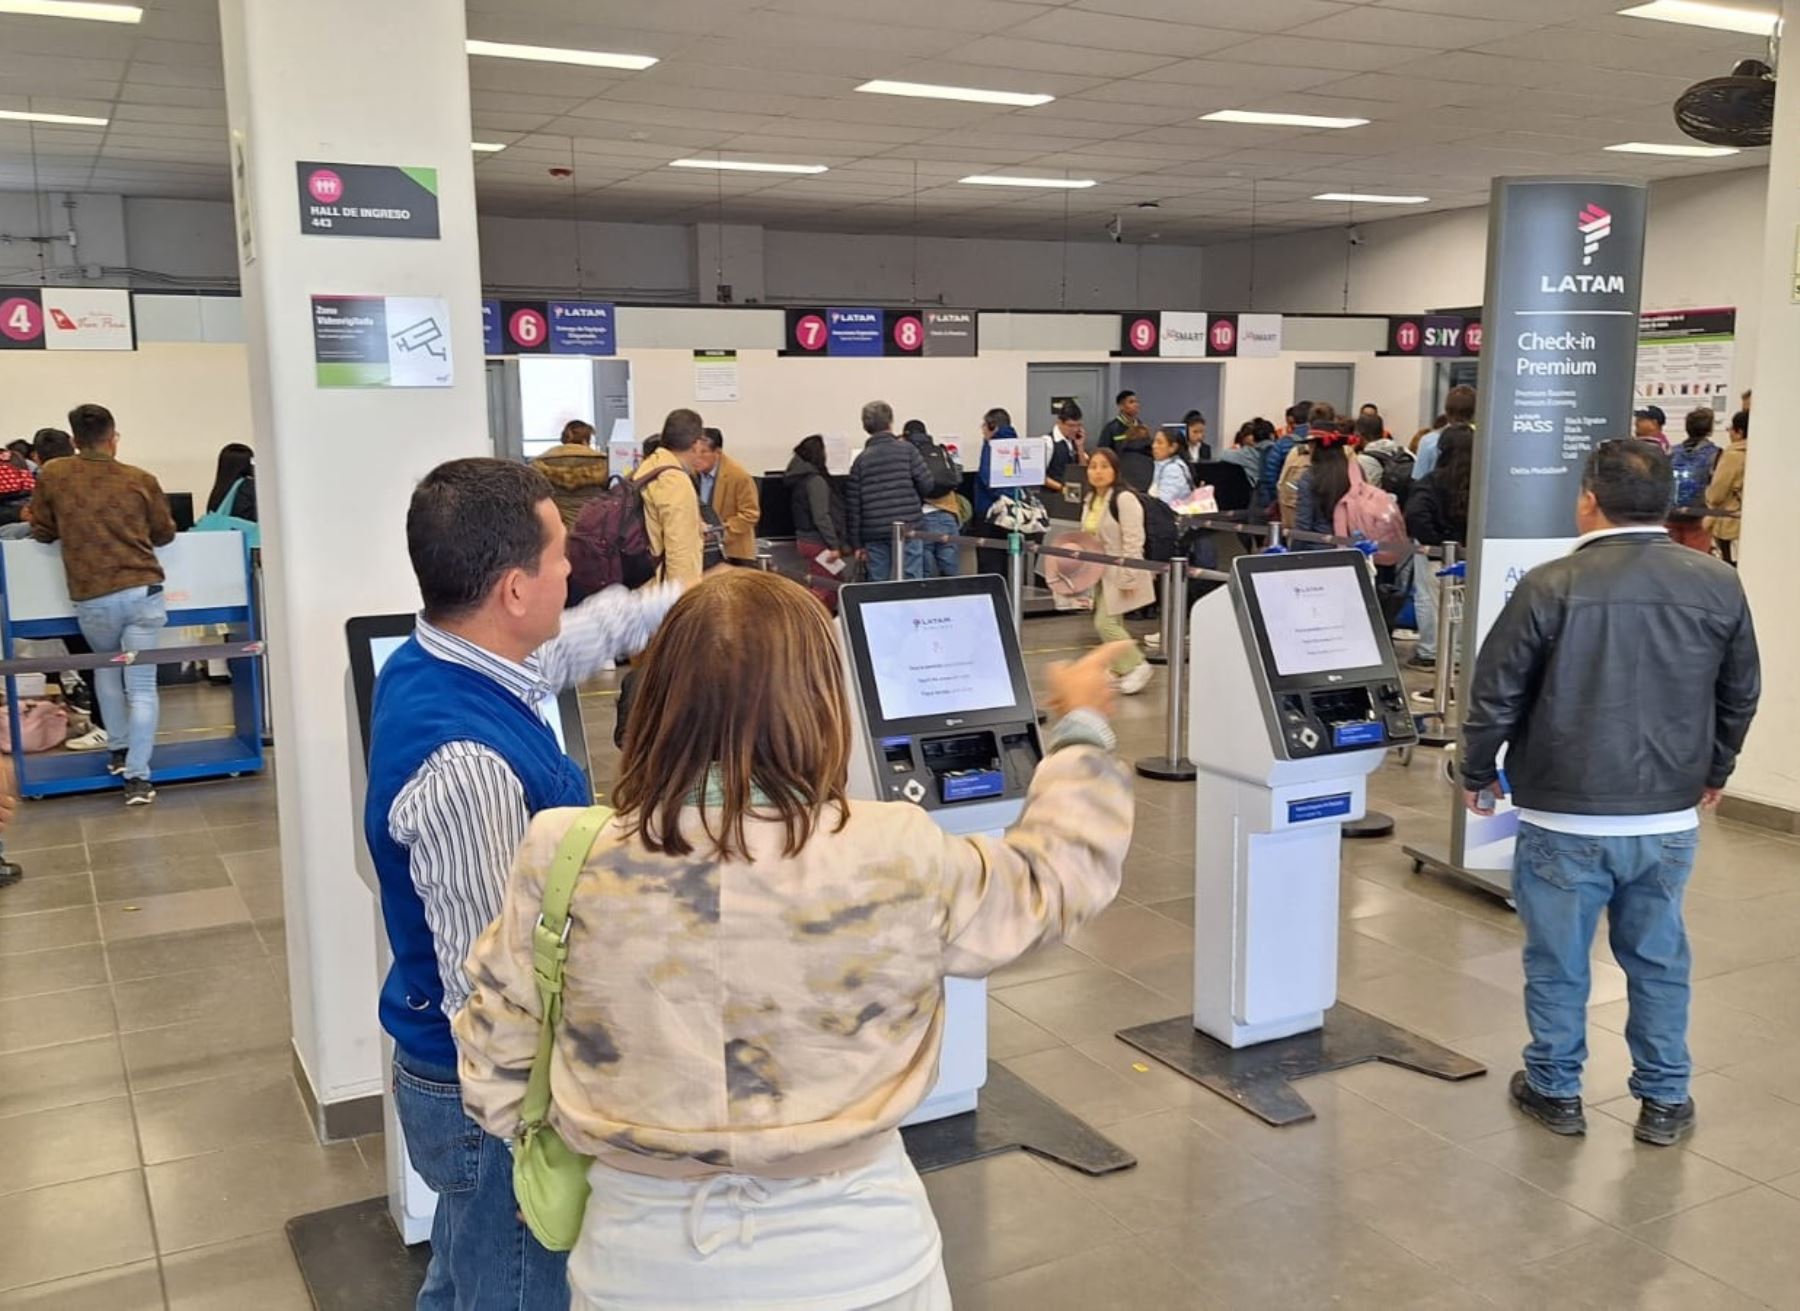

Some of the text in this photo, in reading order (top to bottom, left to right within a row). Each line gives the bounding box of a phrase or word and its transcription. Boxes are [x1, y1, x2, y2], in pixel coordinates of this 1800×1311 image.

[310, 206, 411, 220] HALL DE INGRESO
[1541, 275, 1625, 293] LATAM
[8, 304, 32, 333] 4
[564, 308, 607, 317] LATAM
[840, 314, 876, 322] LATAM
[937, 314, 970, 322] LATAM
[519, 315, 537, 341] 6
[804, 322, 820, 345] 7
[901, 322, 917, 345] 8
[1136, 324, 1150, 346] 9
[1214, 327, 1232, 345] 10
[1401, 328, 1415, 345] 11
[1424, 327, 1460, 347] SKY
[1468, 328, 1482, 345] 12
[1518, 331, 1596, 350] Check-in
[1516, 357, 1597, 376] Premium
[1513, 420, 1554, 433] PASS
